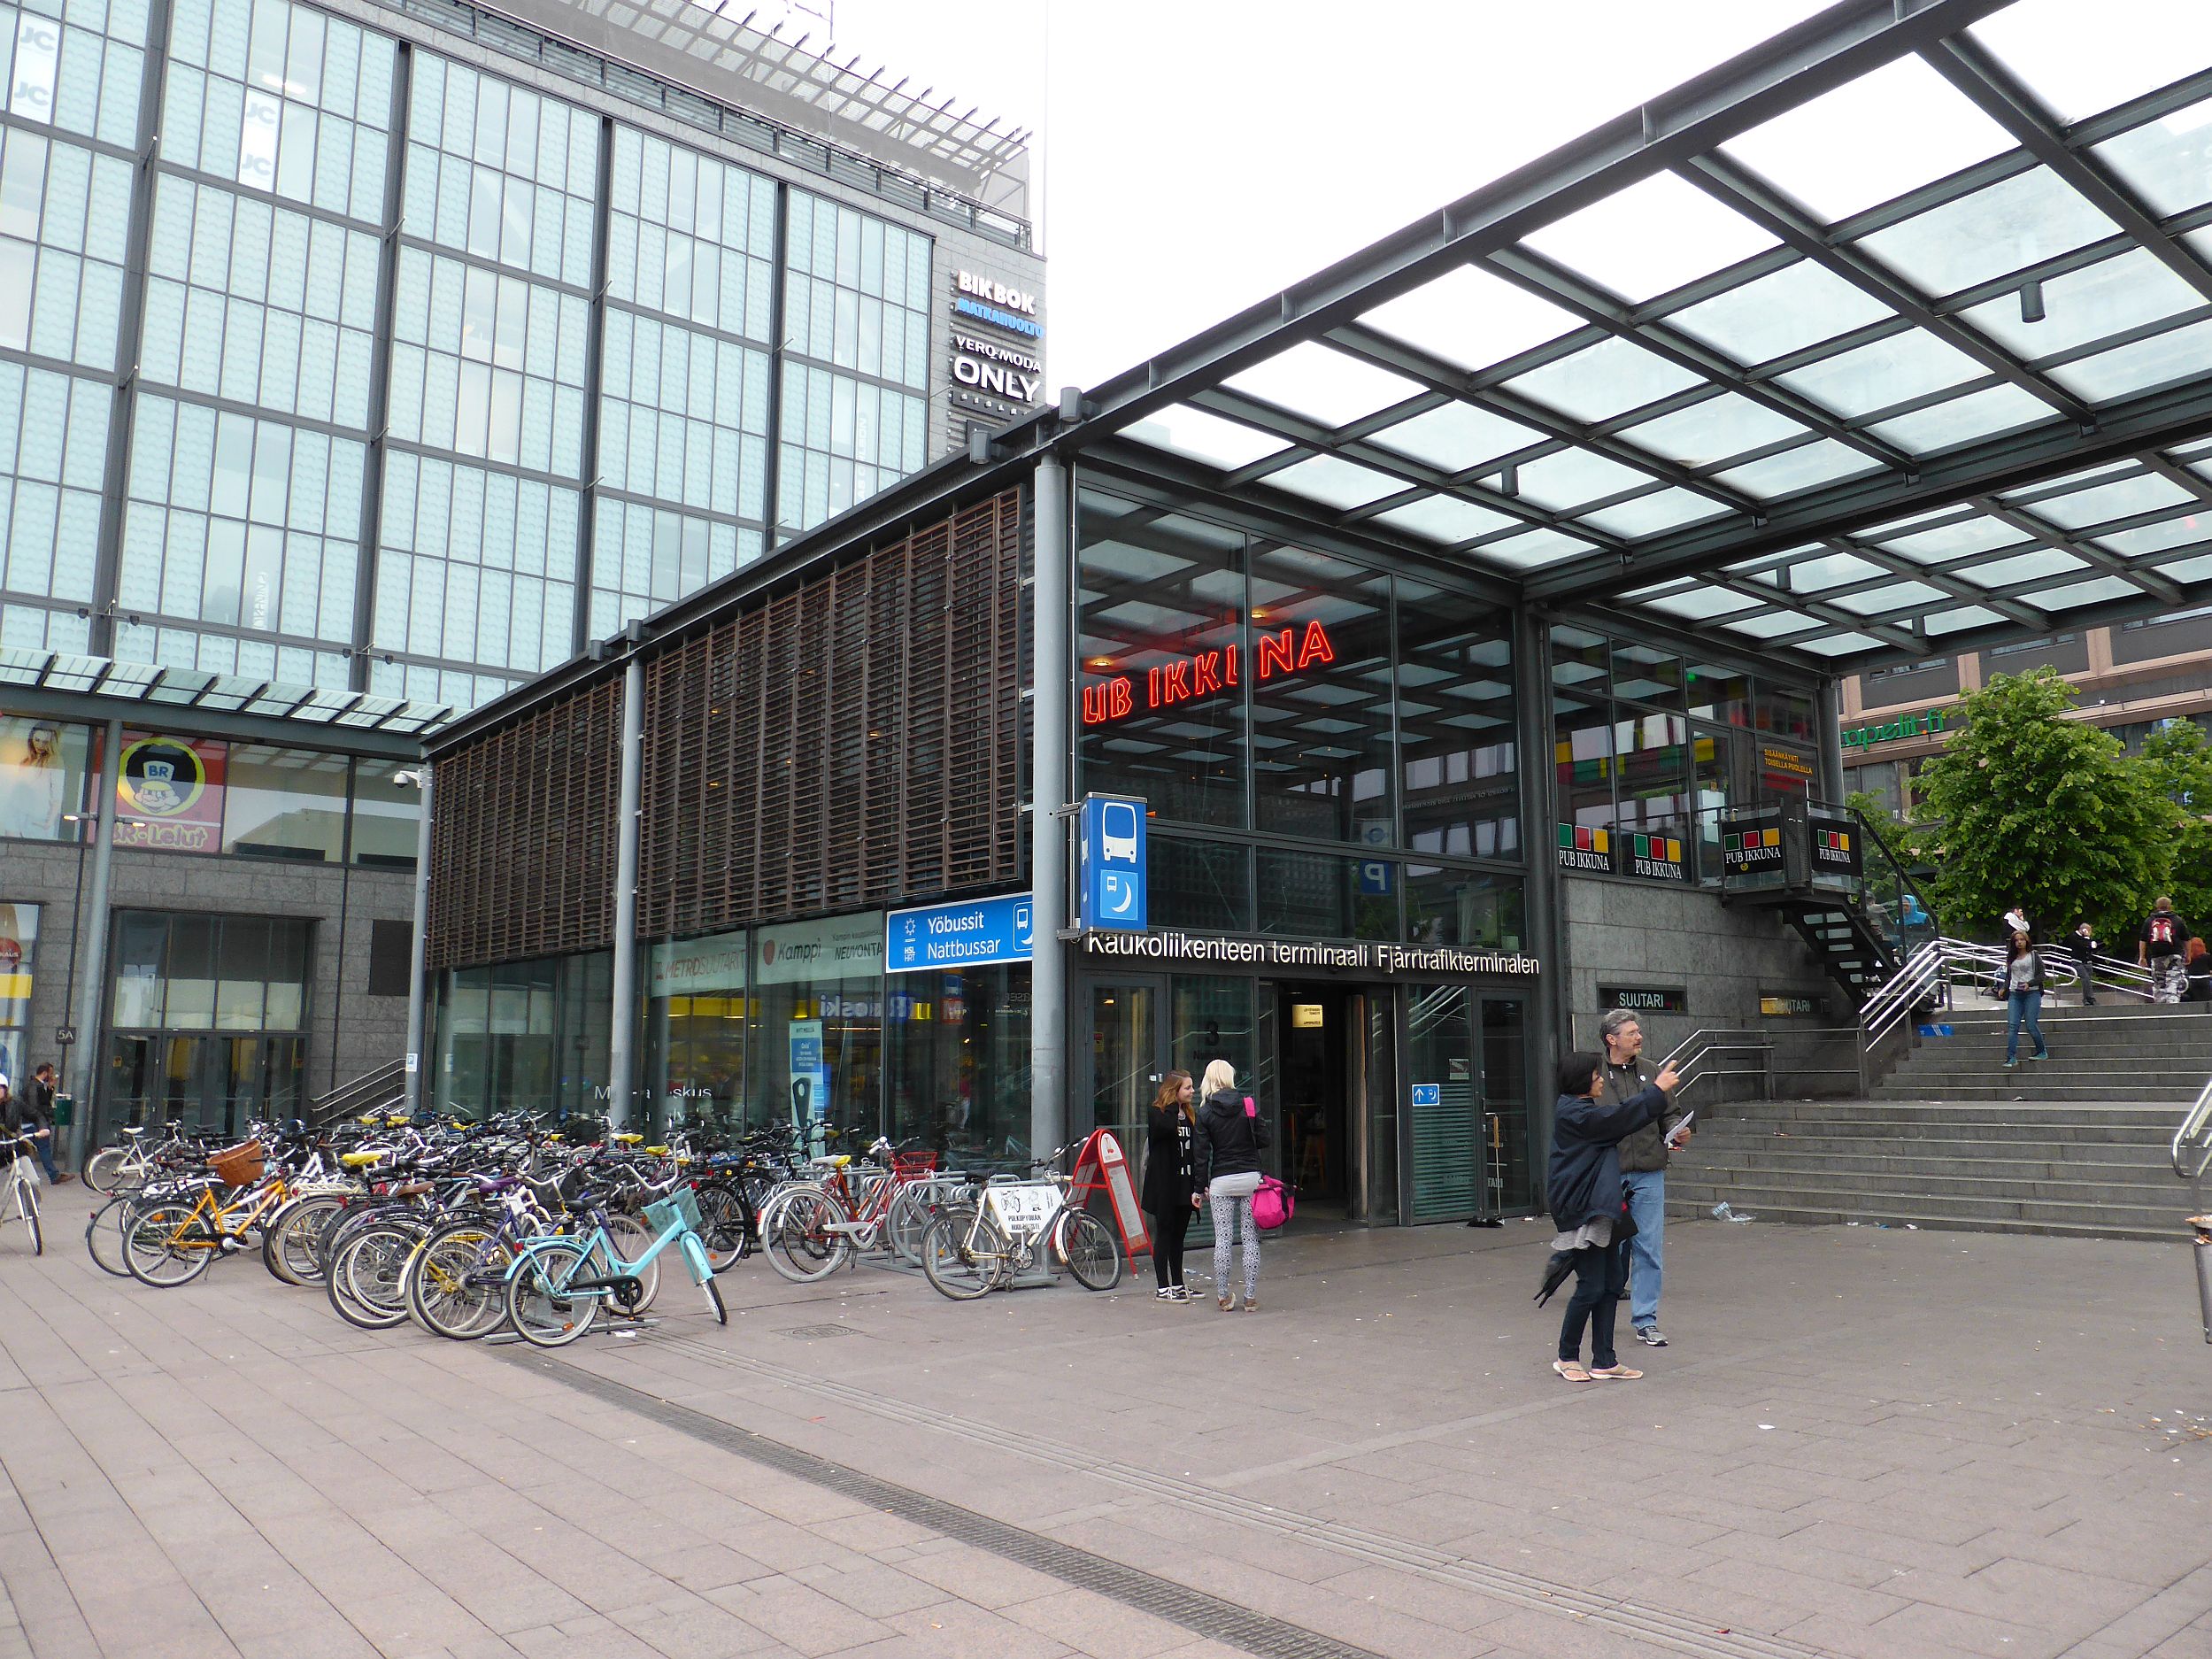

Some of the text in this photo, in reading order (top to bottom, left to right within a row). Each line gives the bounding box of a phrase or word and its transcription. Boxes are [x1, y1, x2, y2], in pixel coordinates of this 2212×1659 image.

[19, 26, 56, 51] JC
[13, 81, 50, 106] JC
[245, 102, 277, 125] JC
[241, 153, 272, 176] JC
[957, 297, 1045, 339] MATKAHUOLTO
[998, 351, 1042, 374] MODA
[954, 356, 1041, 402] ONLY
[1841, 707, 1945, 751] apelit.fi
[148, 765, 169, 779] BR
[1559, 850, 1610, 871] PUB IKKUNA
[1725, 847, 1782, 864] PUB IKKUNA
[1818, 848, 1851, 863] PUB IKKUNA
[1635, 859, 1683, 879] PUB IKKUNA
[928, 911, 985, 935] Yöbussit
[779, 938, 821, 964] Kamppi
[835, 942, 882, 961] NEUVONTA
[904, 946, 916, 955] HSL
[927, 938, 1001, 960] Nattbussar
[1088, 931, 1539, 975] Kaukoliikenteen terminaali Fjärrtrafikterminalen
[1619, 992, 1664, 1007] SUUTARI
[58, 1030, 73, 1040] 5A
